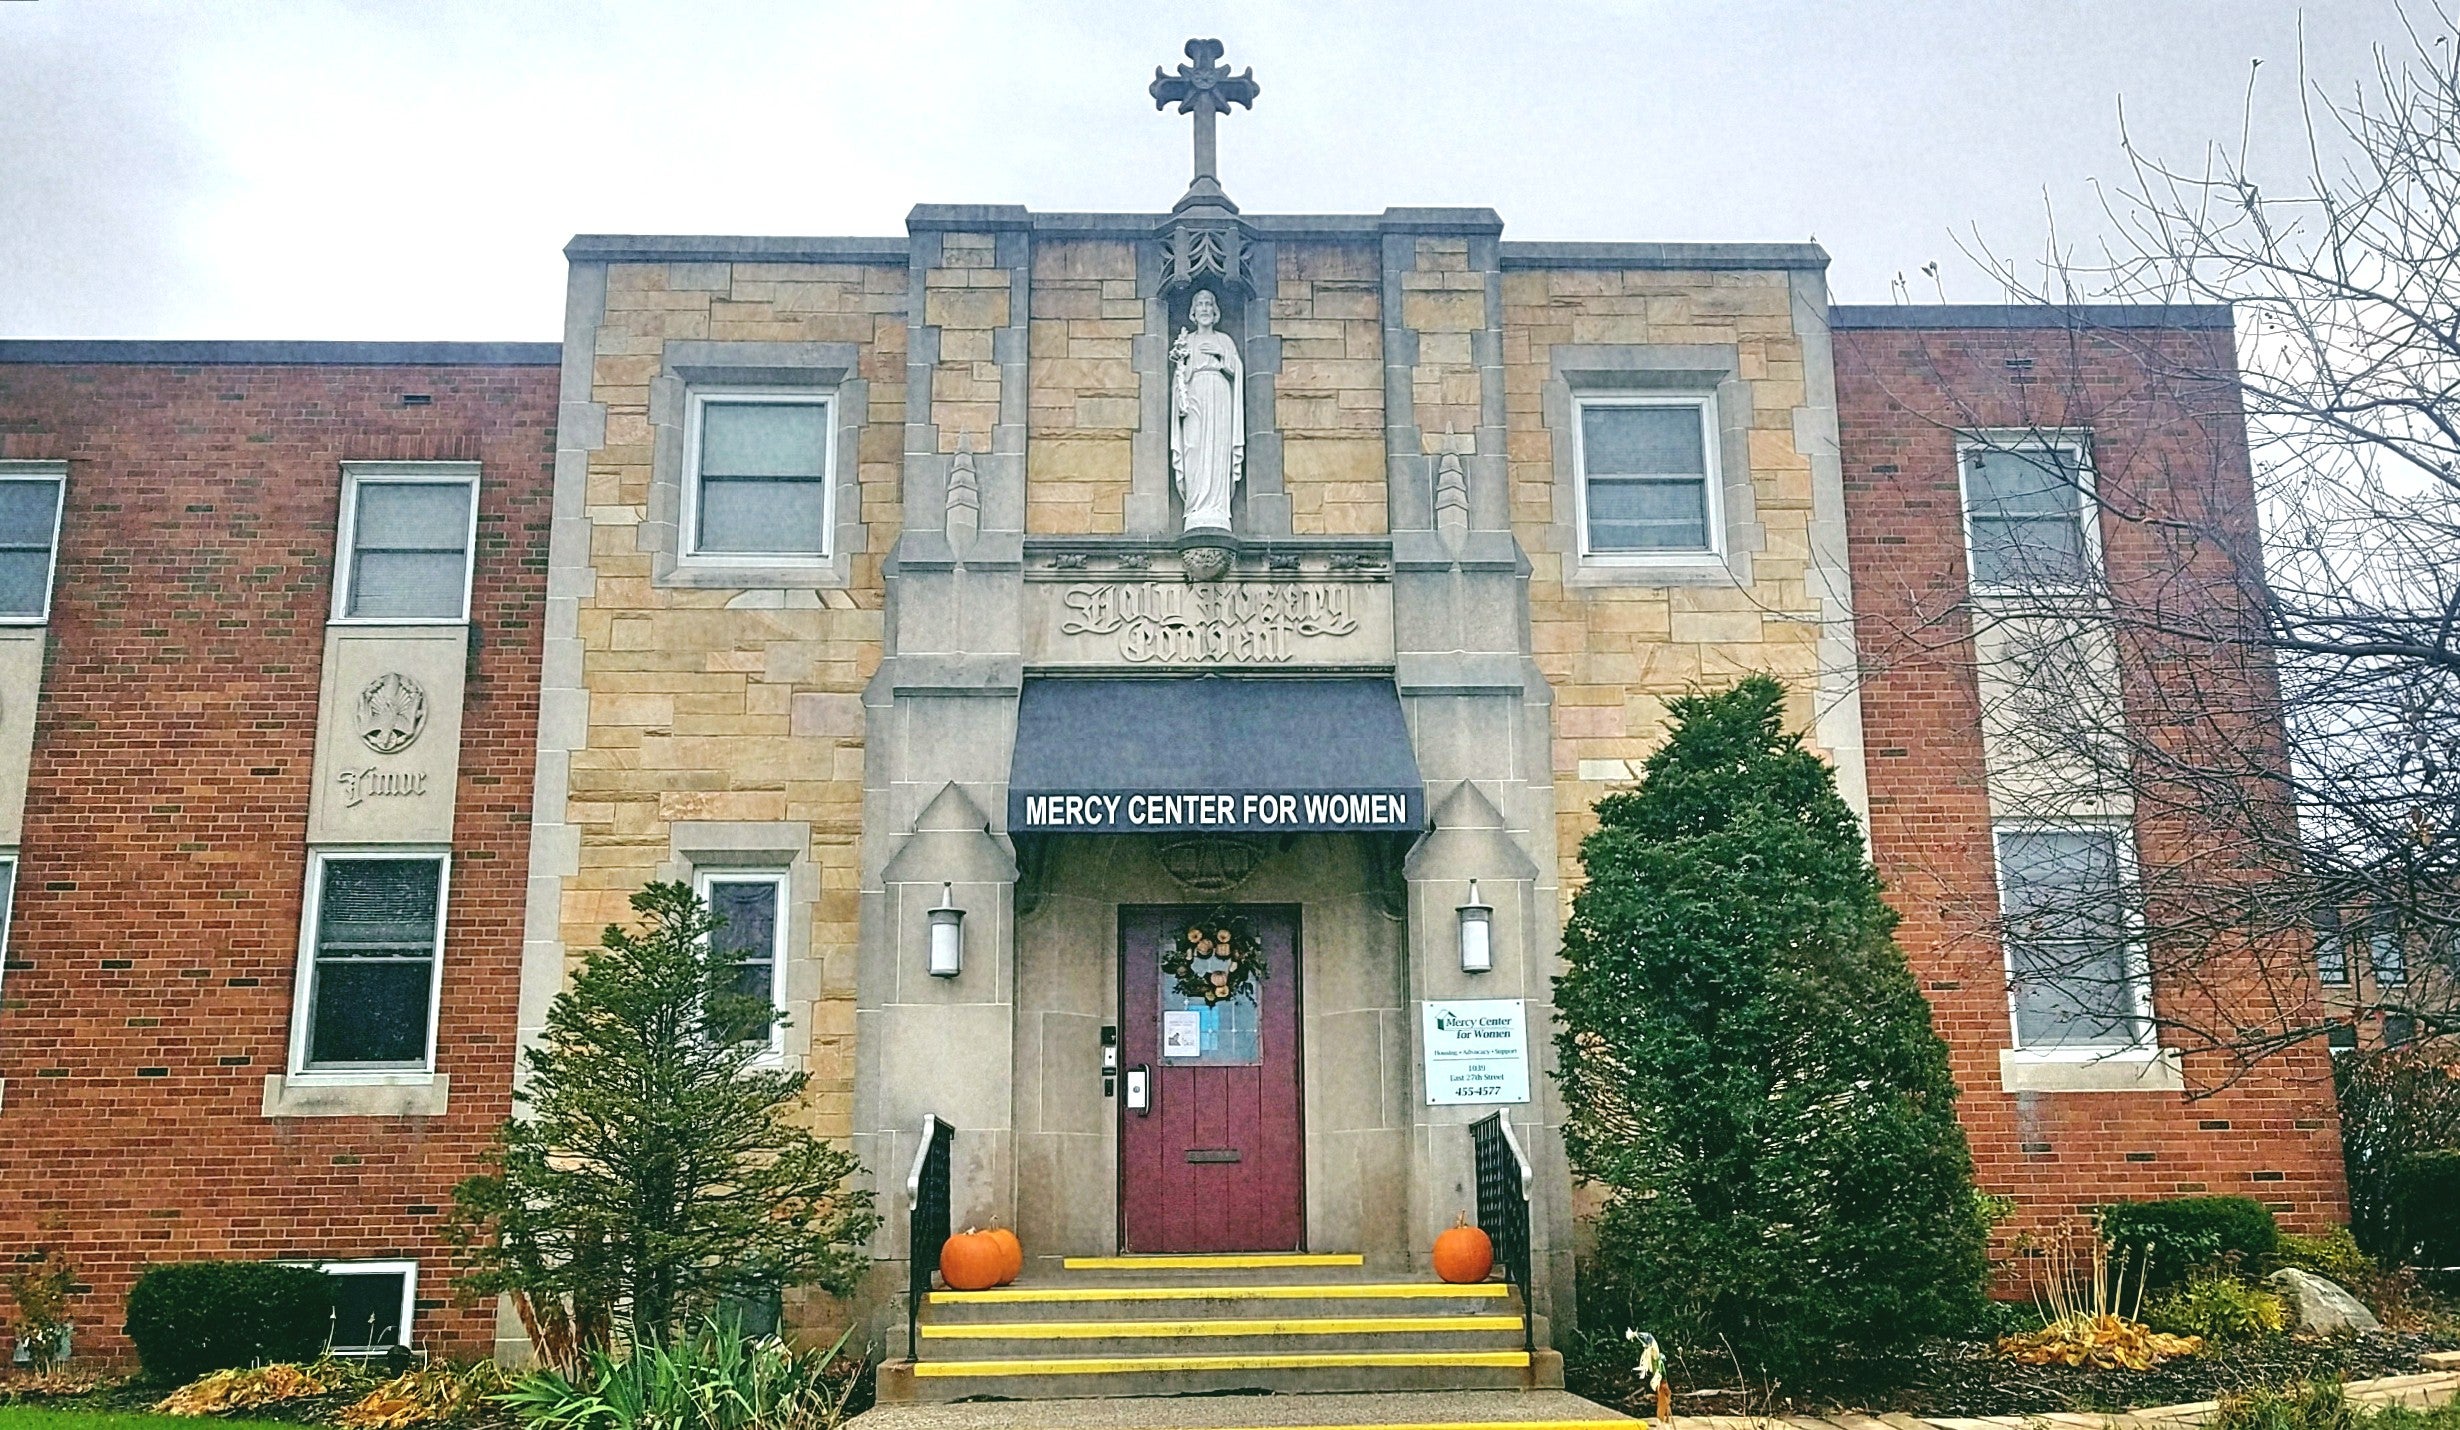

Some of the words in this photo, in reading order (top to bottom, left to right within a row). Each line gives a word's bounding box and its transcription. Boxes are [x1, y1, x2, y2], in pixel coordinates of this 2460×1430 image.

[1061, 582, 1191, 634] Holy
[1118, 617, 1294, 662] Convent
[1026, 795, 1122, 825] MERCY
[1128, 795, 1236, 825] CENTER
[1242, 794, 1299, 824] FOR
[1303, 794, 1407, 824] WOMEN
[1446, 1018, 1477, 1029] Mercy
[1479, 1017, 1512, 1026] Center
[1456, 1030, 1471, 1039] for
[1474, 1029, 1511, 1039] Women
[1455, 1086, 1501, 1096] 455-4577
